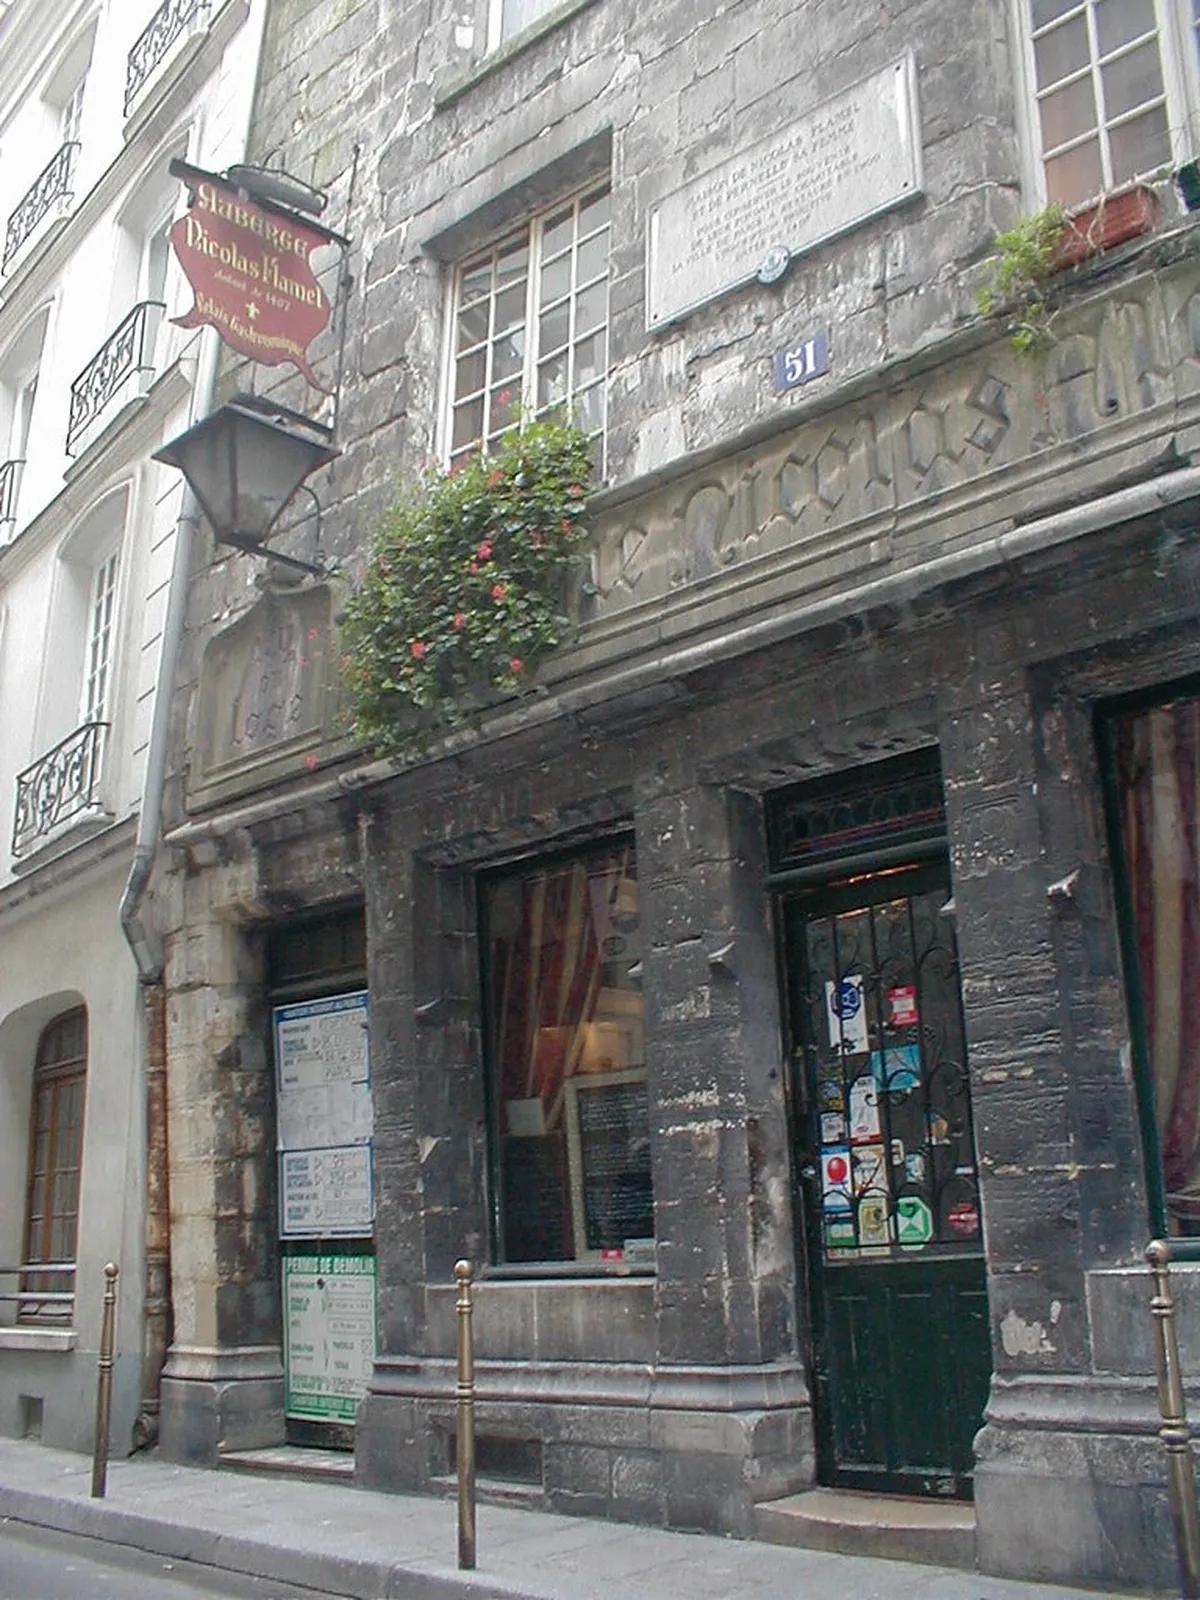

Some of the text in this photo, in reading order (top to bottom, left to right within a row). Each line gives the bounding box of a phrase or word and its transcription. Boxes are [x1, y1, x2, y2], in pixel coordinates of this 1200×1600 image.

[184, 216, 323, 309] Nicolas Flamel
[783, 340, 818, 383] 51
